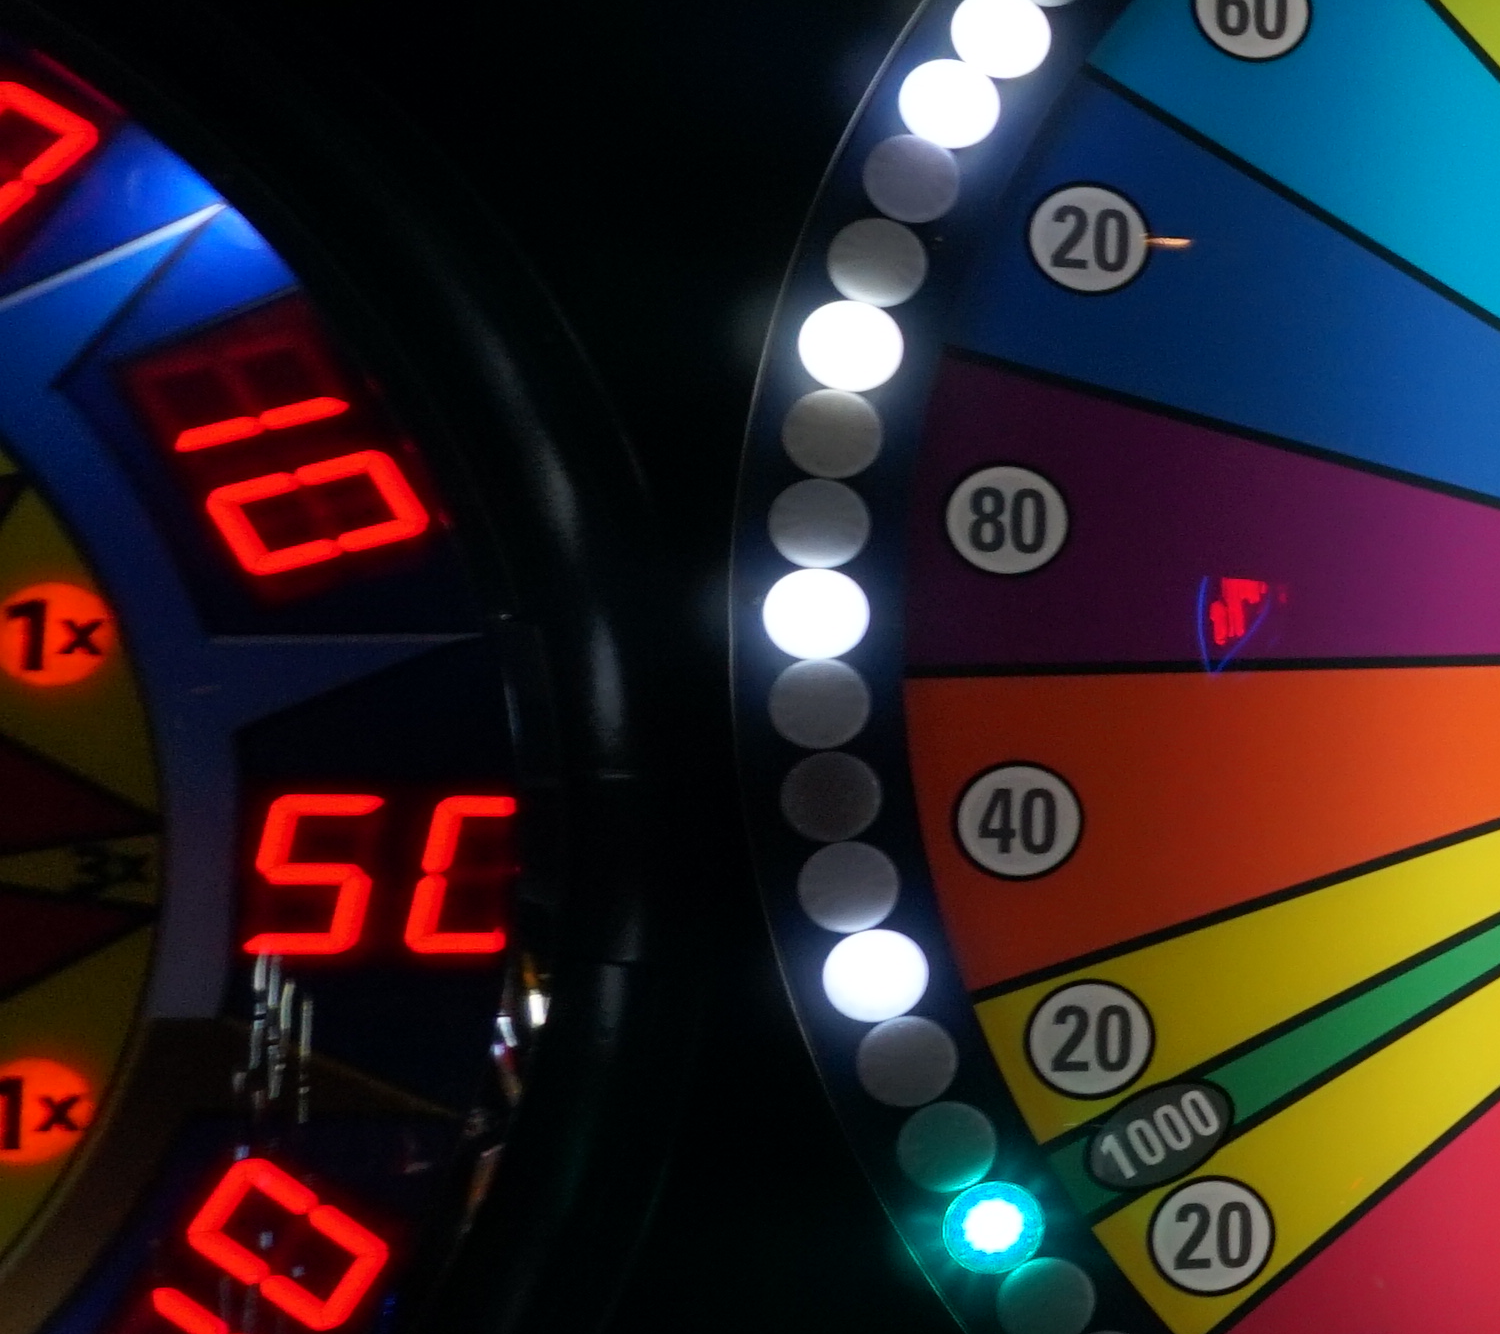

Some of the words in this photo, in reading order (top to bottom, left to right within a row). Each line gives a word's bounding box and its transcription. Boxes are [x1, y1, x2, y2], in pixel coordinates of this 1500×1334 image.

[1051, 205, 1131, 273] 20
[175, 397, 430, 577] 10
[967, 486, 1047, 554] 80
[5, 600, 105, 671] 1x
[978, 788, 1057, 853] 40
[1052, 1004, 1132, 1072] 20
[1099, 1093, 1219, 1179] 1000
[1172, 1203, 1253, 1268] 20
